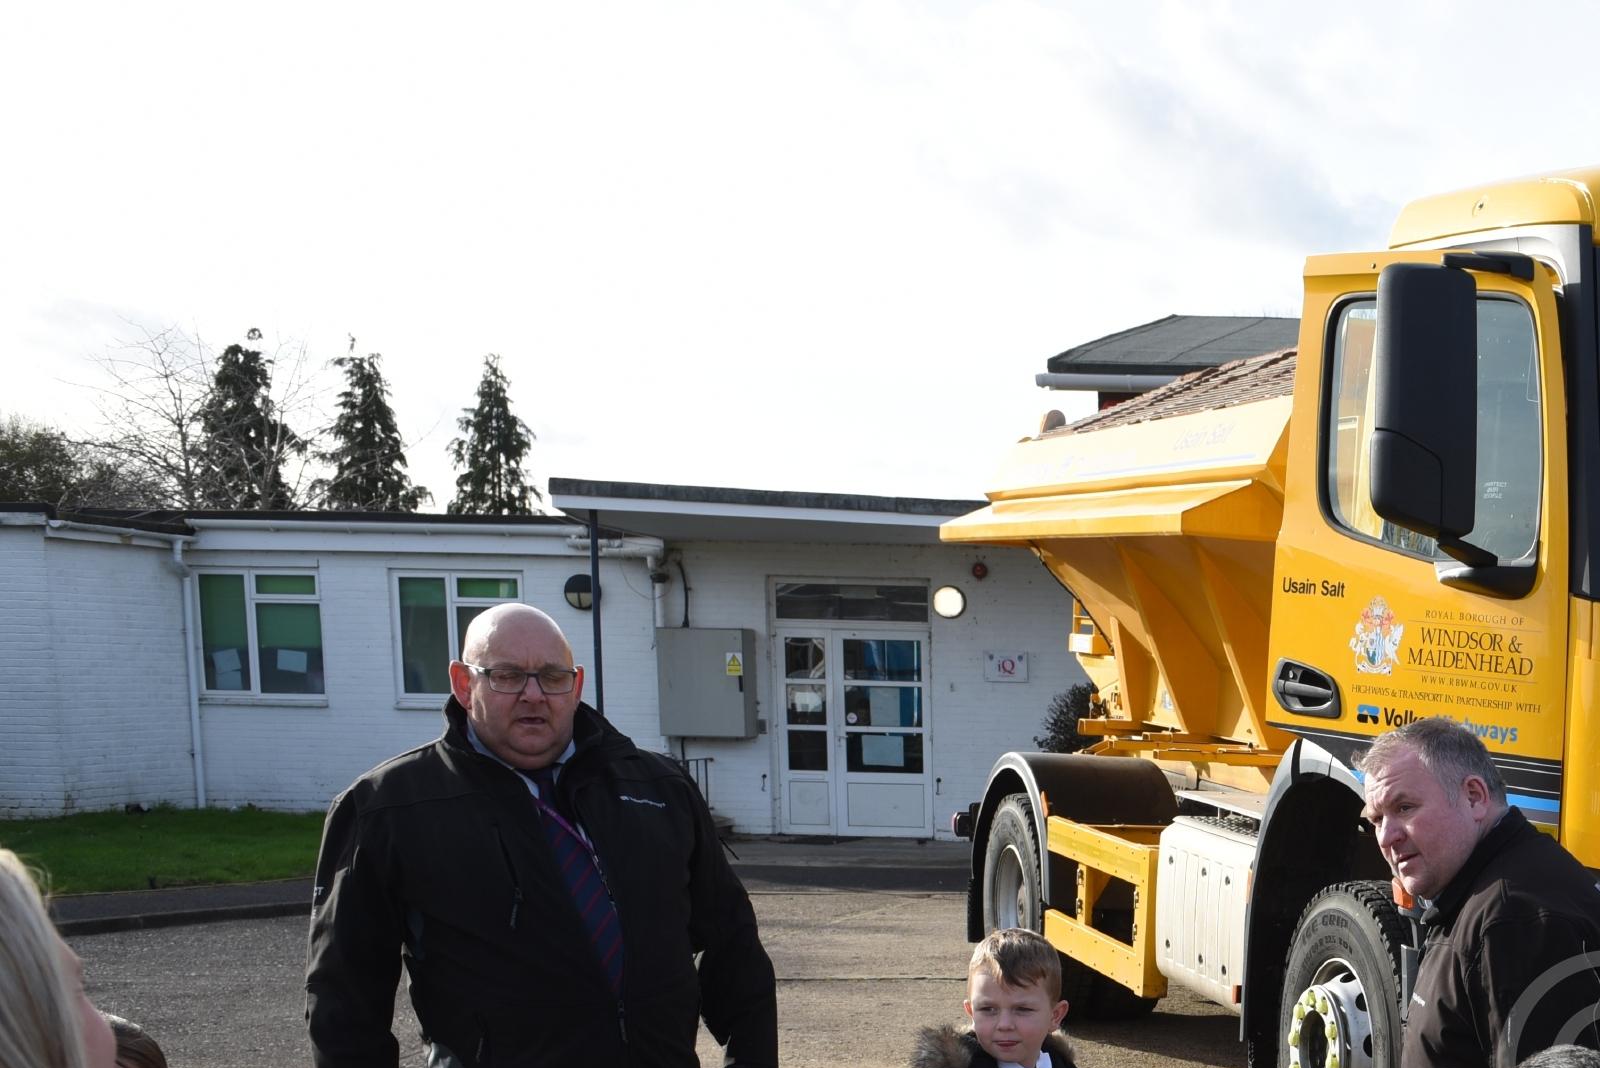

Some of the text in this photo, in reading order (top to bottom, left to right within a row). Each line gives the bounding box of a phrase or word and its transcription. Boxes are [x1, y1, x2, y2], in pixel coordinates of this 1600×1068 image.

[1283, 577, 1345, 598] Usain Salt
[1425, 609, 1525, 626] ROYAL BOROUGH OF
[1421, 626, 1523, 654] WINDSOR &
[1407, 647, 1534, 676] MAIDENHEAD
[1421, 675, 1518, 693] WWW.RBWM.GOV.UK
[1352, 684, 1542, 714] HIGHWAYS & TRANSPORT IN PARTNERSHIP WITH
